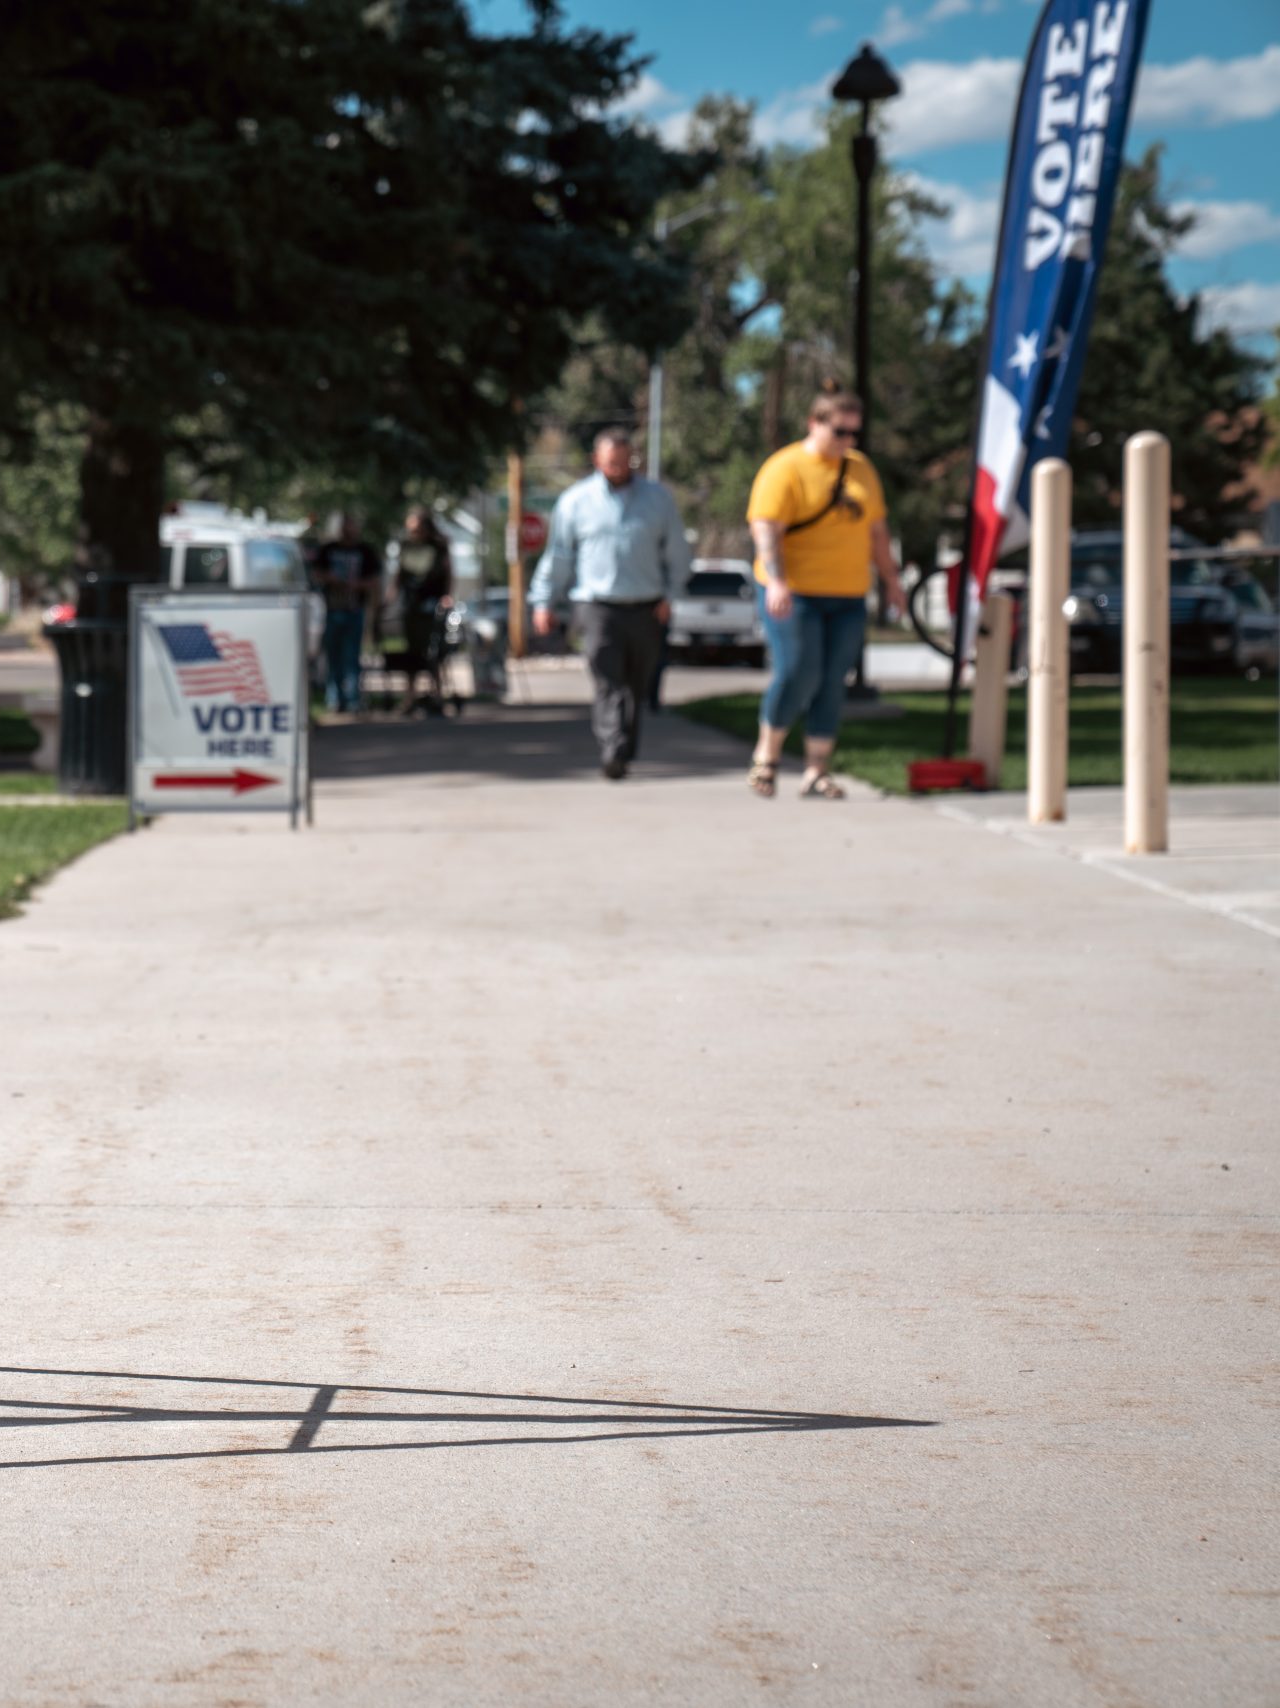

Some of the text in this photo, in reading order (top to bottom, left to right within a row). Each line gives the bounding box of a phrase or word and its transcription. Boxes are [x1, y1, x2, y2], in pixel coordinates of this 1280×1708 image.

[1024, 19, 1088, 271] VOTE
[192, 704, 290, 733] VOTE
[207, 739, 273, 757] HERE
